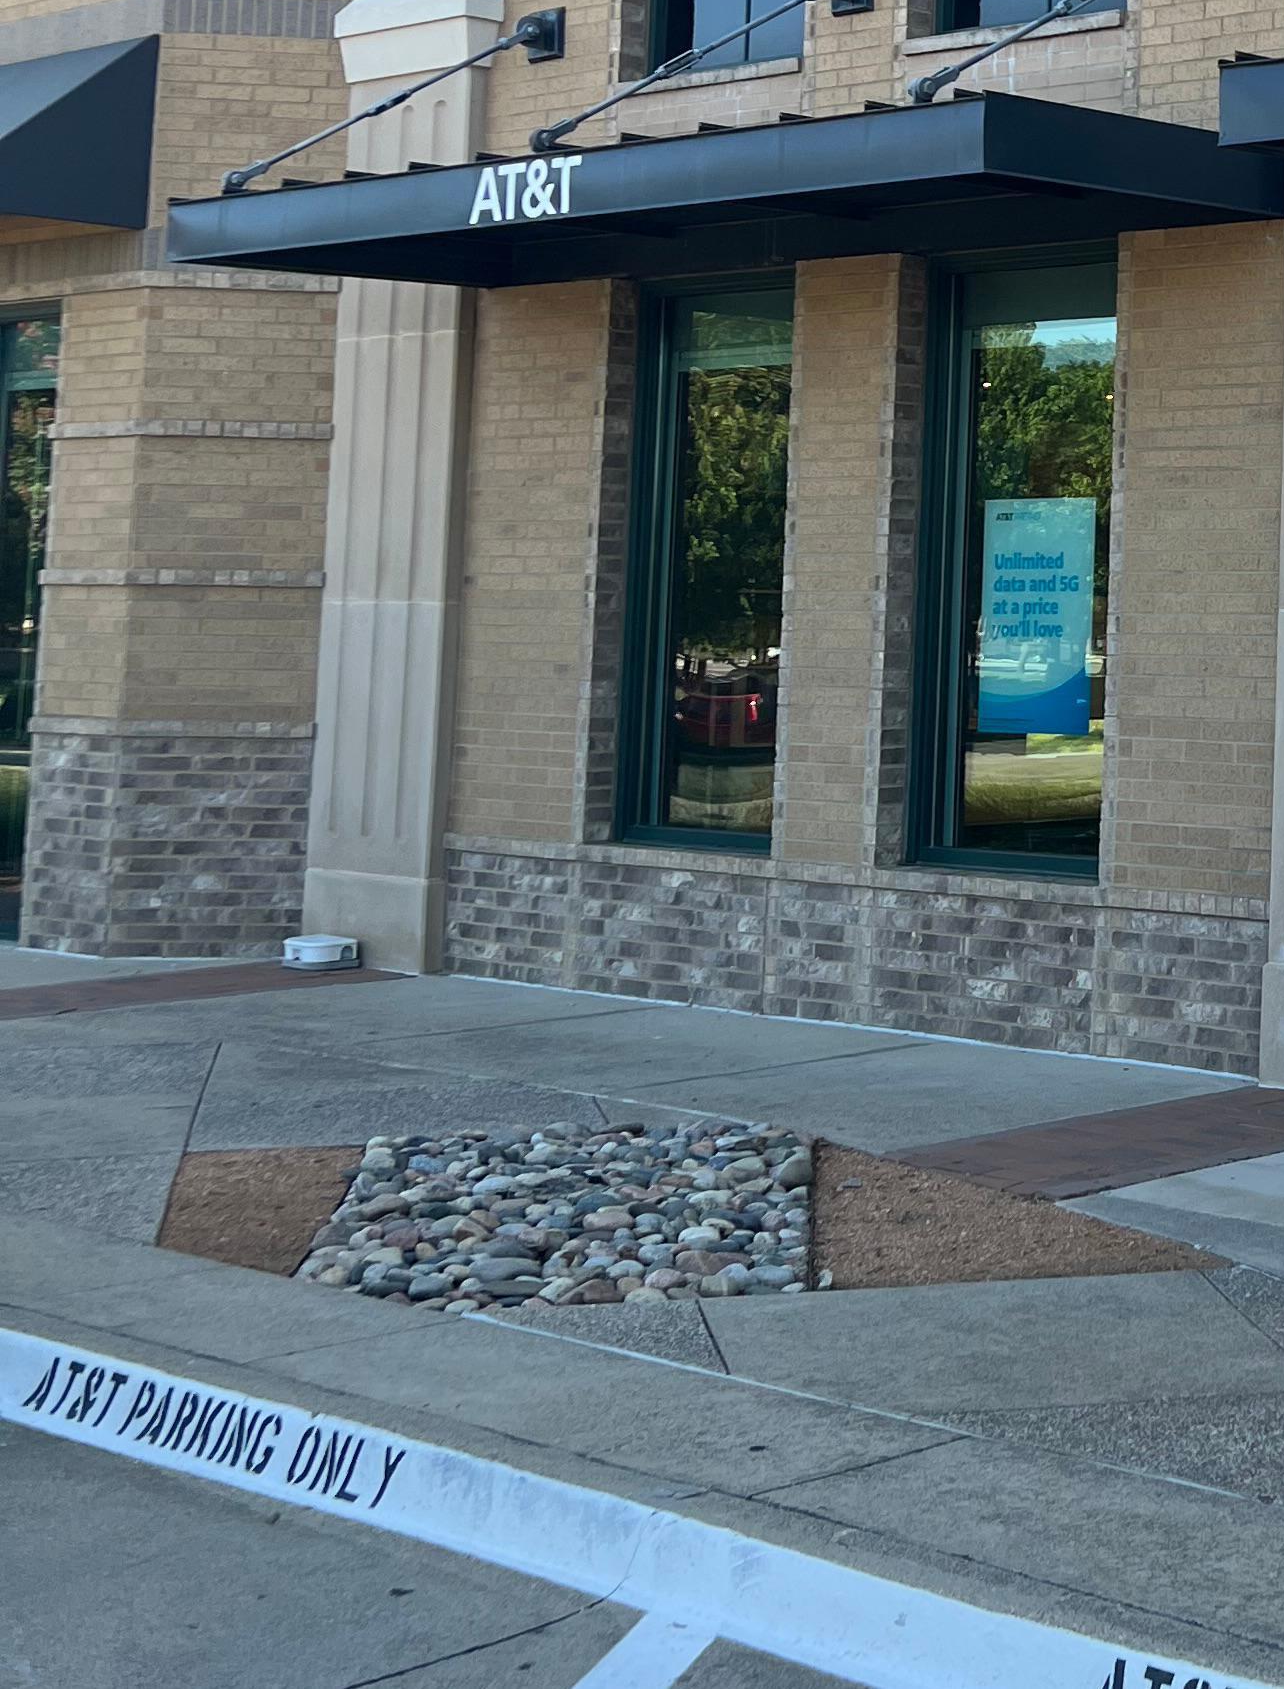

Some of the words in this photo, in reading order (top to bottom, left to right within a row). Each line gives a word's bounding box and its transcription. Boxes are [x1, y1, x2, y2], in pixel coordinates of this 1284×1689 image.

[468, 155, 582, 224] AT&T
[994, 551, 1064, 570] Unlimited
[993, 575, 1026, 592] data
[1029, 575, 1056, 592] and
[1059, 575, 1079, 592] 5G
[993, 599, 1008, 615] at
[1011, 603, 1020, 615] a
[1022, 598, 1059, 619] price
[992, 620, 1030, 640] you'll
[1034, 621, 1063, 638] love
[22, 1356, 128, 1428] AT&T
[116, 1379, 283, 1475] PARKING
[286, 1425, 407, 1510] ONLY
